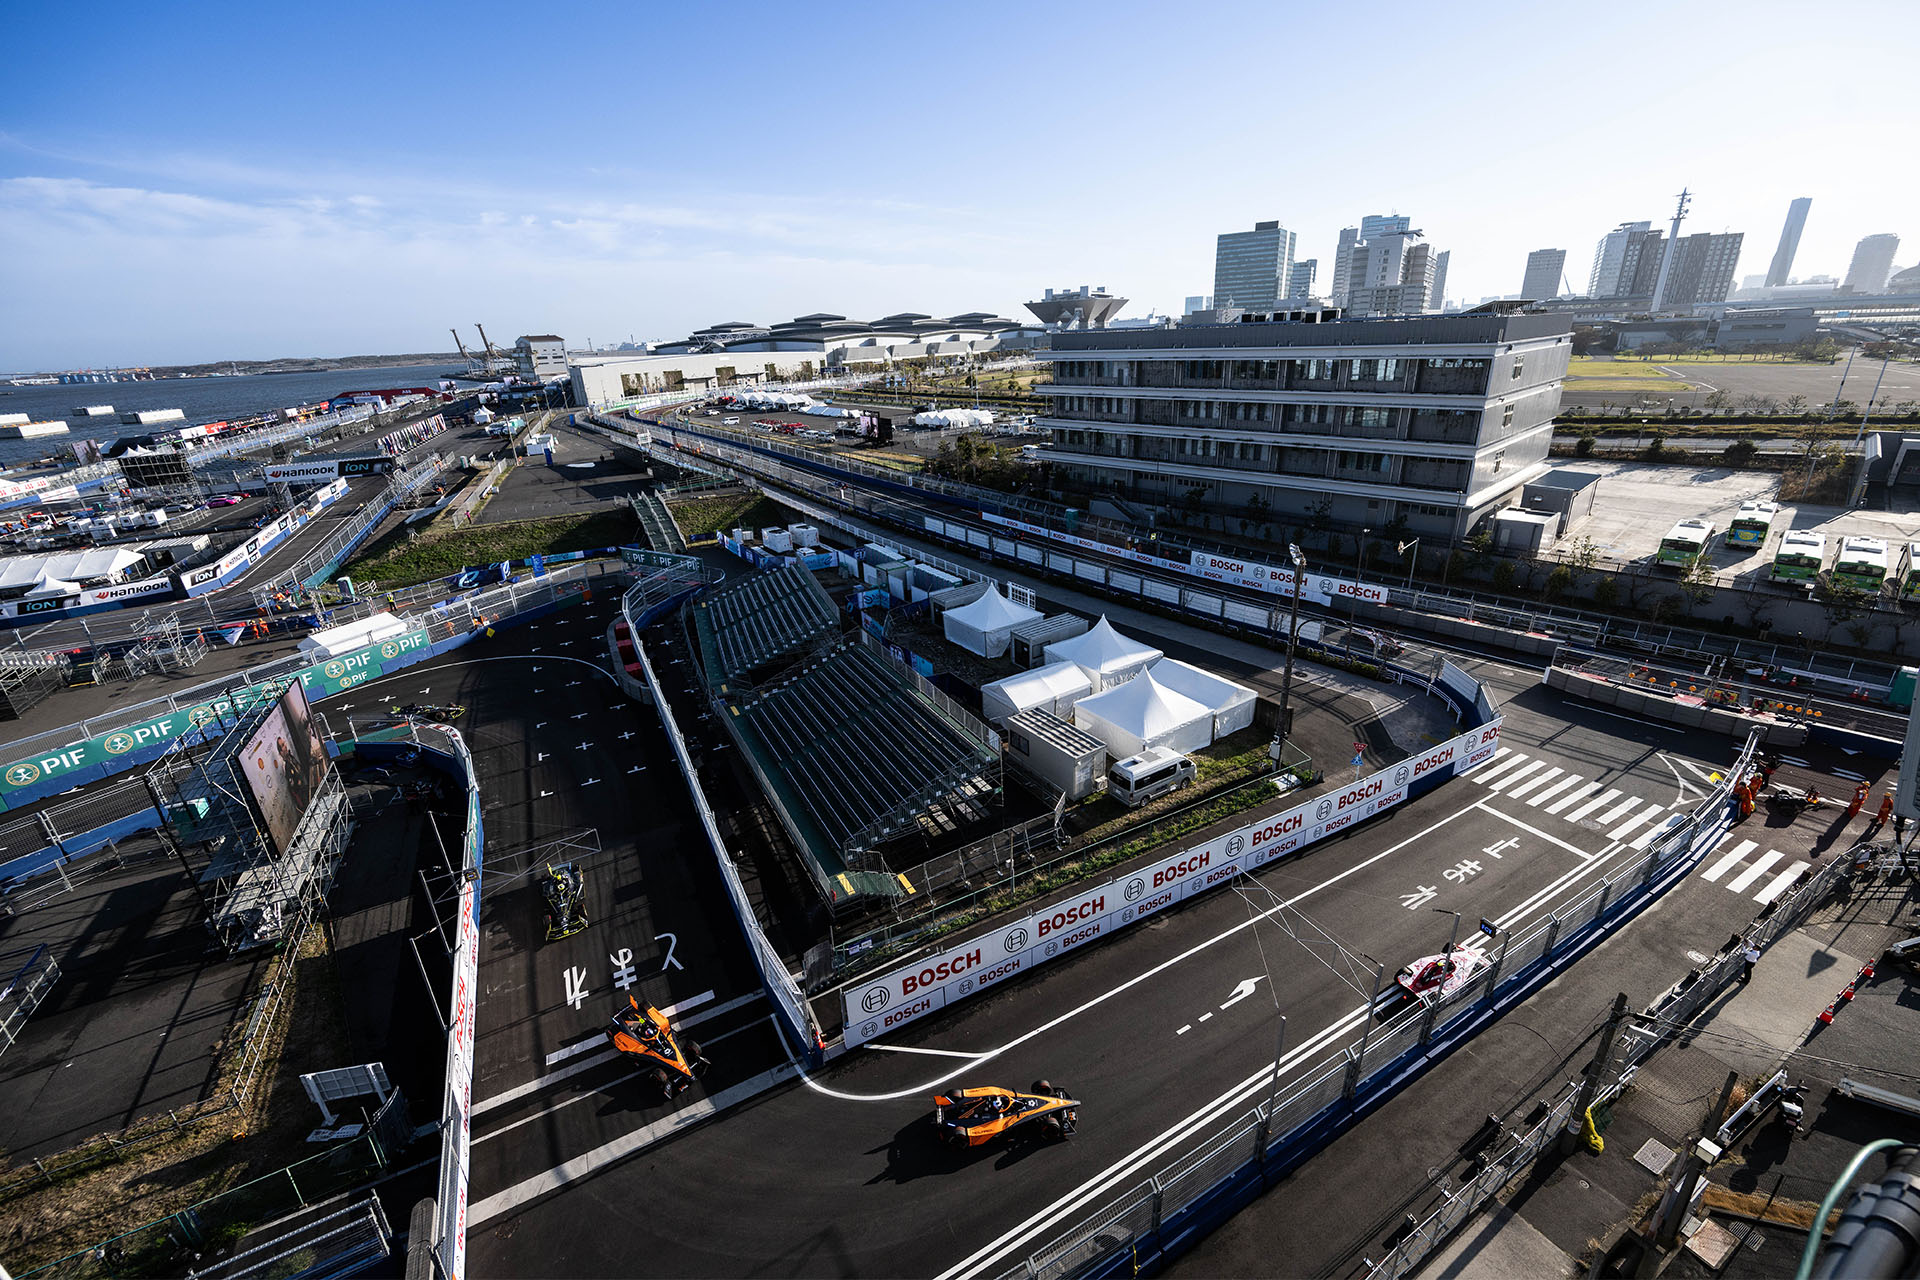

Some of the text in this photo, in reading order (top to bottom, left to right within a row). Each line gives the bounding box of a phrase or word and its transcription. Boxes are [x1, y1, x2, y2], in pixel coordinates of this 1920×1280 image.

[632, 553, 645, 563] PIF
[659, 556, 672, 567] PIF
[1136, 554, 1153, 563] BOSCH
[1168, 562, 1186, 571] BOSCH
[1210, 558, 1244, 574] BOSCH
[1203, 570, 1223, 580] BOSCH
[1241, 579, 1263, 589] BOSCH
[1338, 583, 1381, 601] BOSCH
[399, 634, 423, 652] PIF
[344, 652, 371, 671] PIF
[351, 671, 368, 684] PIF
[133, 719, 173, 744] PIF
[40, 748, 86, 775] PIF
[1414, 747, 1454, 777] BOSCH
[1469, 748, 1491, 765] BOSCH
[1338, 779, 1383, 810] BOSCH
[1377, 791, 1402, 809] BOSCH
[1252, 814, 1303, 847] BOSCH
[1325, 815, 1352, 833] BOSCH
[1268, 838, 1297, 858] BOSCH
[1153, 851, 1210, 888] BOSCH
[1207, 864, 1238, 885] BOSCH
[1398, 836, 1521, 911] 止まれ
[1138, 893, 1173, 915] BOSCH
[1038, 896, 1105, 937] BOSCH
[1062, 924, 1101, 949] BOSCH
[562, 933, 684, 1010] とまれ
[902, 949, 981, 995] BOSCH
[979, 959, 1021, 986] BOSCH
[884, 999, 931, 1028] BOSCH
